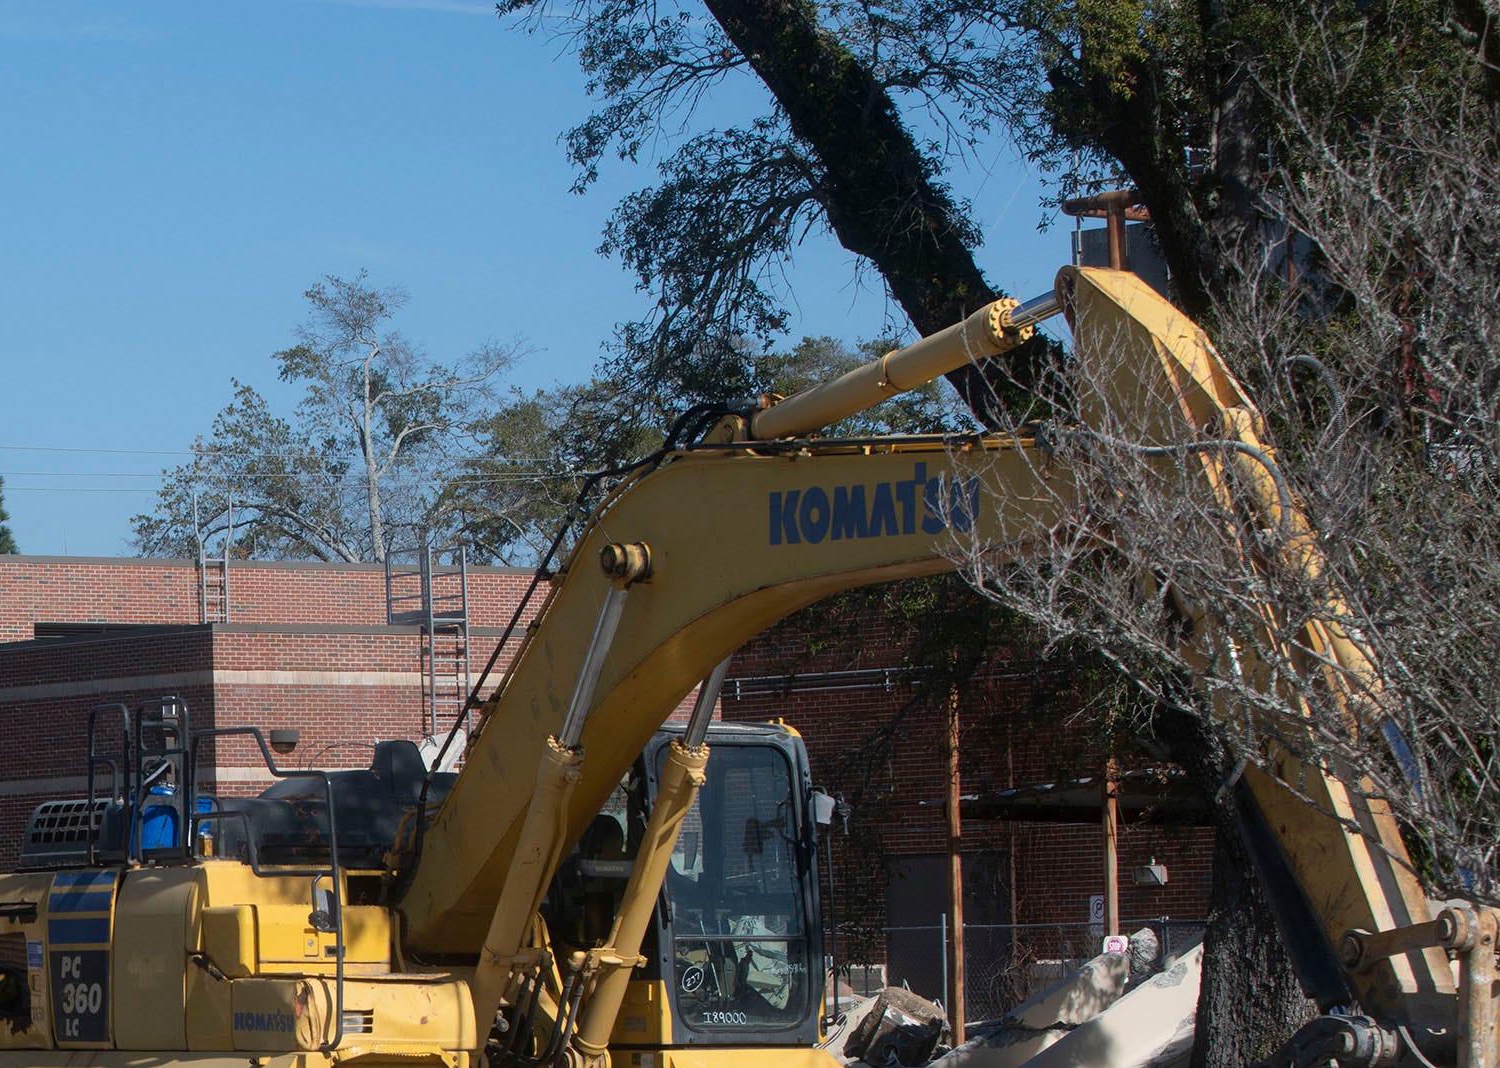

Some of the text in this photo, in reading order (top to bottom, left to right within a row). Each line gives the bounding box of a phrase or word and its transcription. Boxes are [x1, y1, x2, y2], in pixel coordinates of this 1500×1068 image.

[769, 462, 980, 546] KOMATSU
[61, 956, 82, 979] PC
[62, 983, 102, 1014] 360
[65, 1019, 79, 1037] LC
[234, 1008, 294, 1032] KOMATSU
